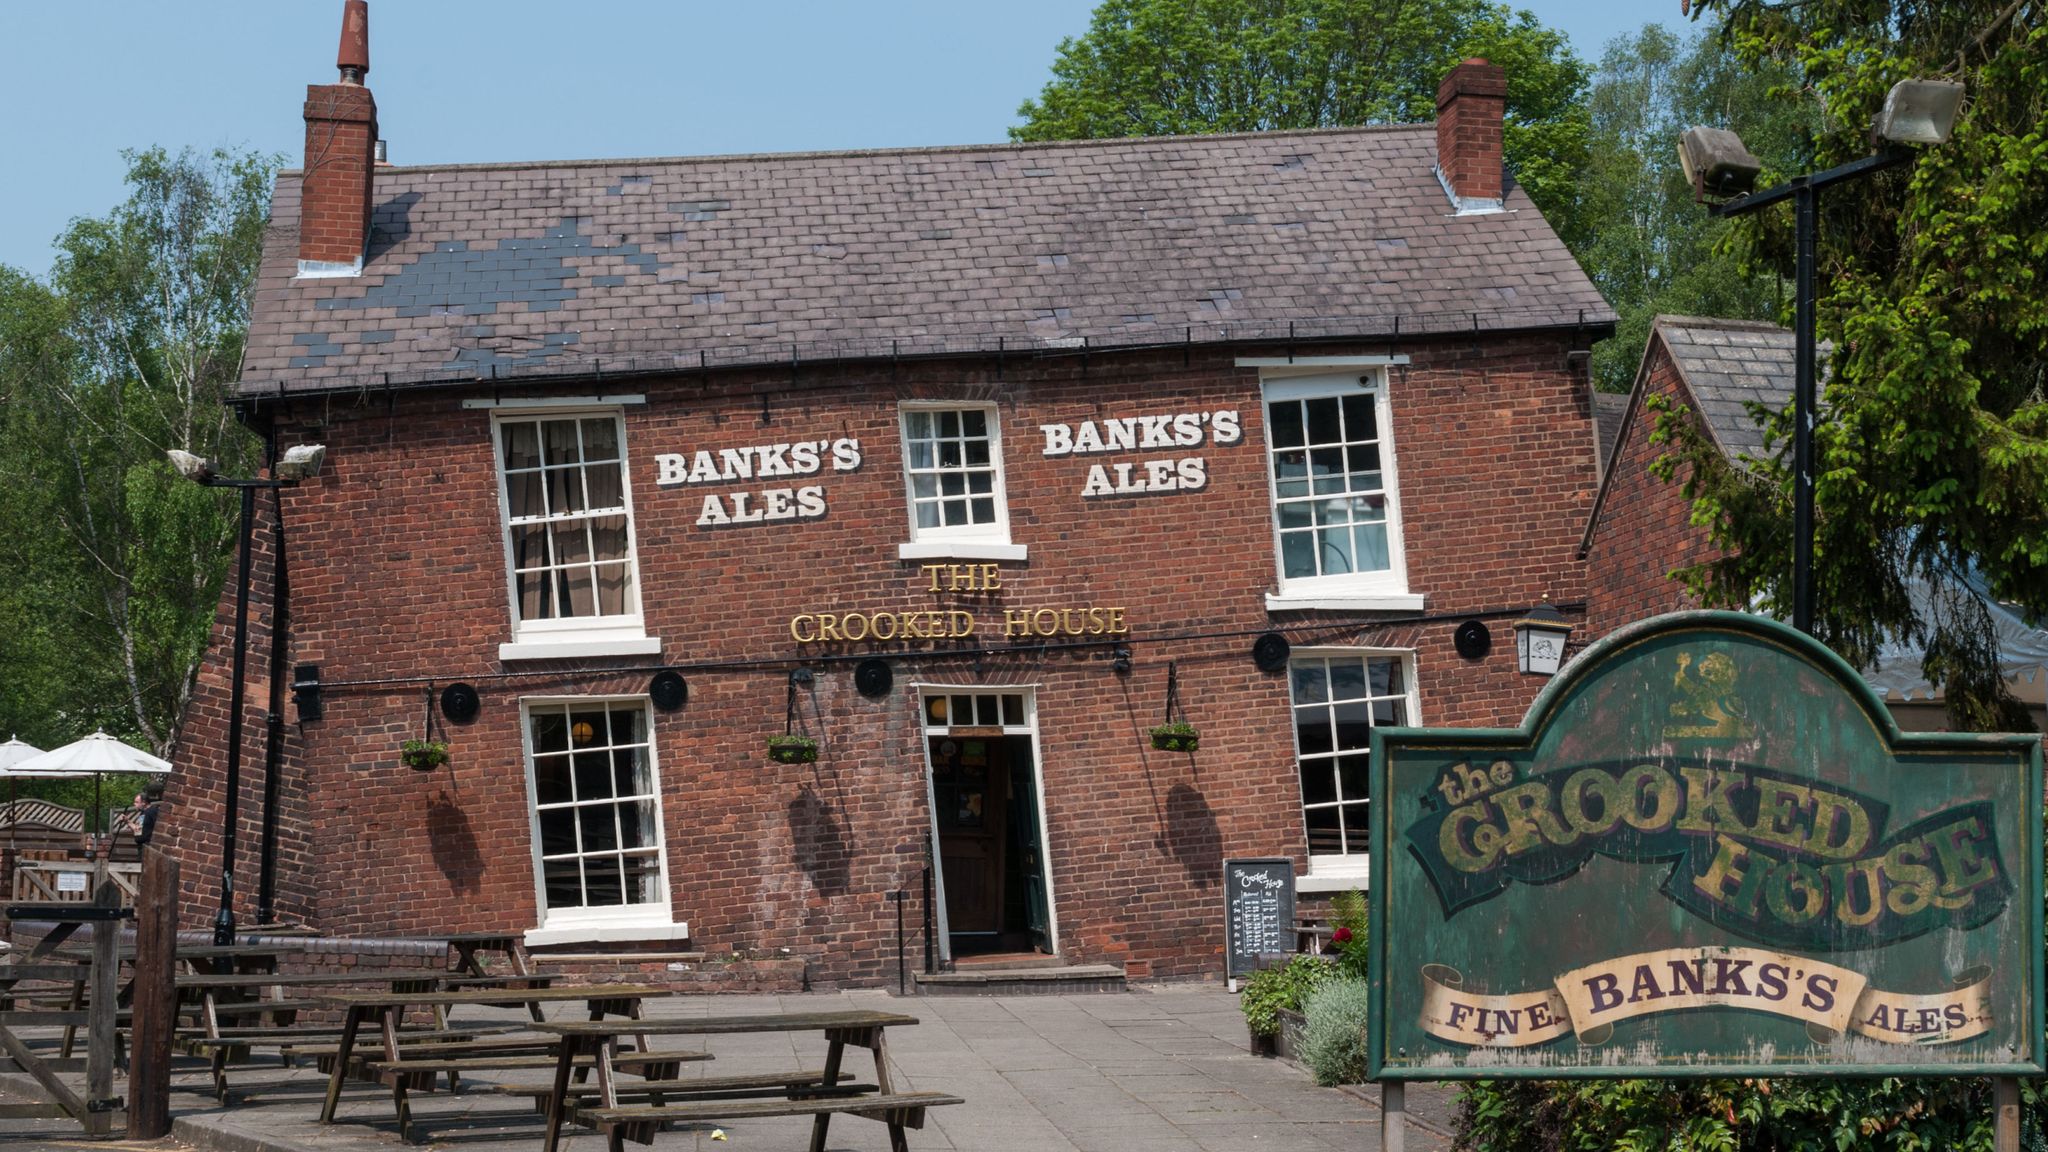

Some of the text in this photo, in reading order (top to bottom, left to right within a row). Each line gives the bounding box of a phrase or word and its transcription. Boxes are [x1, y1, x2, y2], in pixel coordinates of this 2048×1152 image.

[1041, 410, 1241, 455] BANKS'S
[655, 438, 861, 485] BANKS'S
[1082, 457, 1206, 497] ALES
[696, 485, 826, 525] ALES
[923, 563, 1001, 592] THE
[791, 606, 1128, 642] CROOKED HOUSE
[1438, 760, 1514, 806] the
[1439, 764, 1872, 873] CROOKED
[1693, 816, 1995, 926] HOUSE
[1583, 958, 1839, 1013] BANKS'S
[1446, 1000, 1967, 1034] FINE ALES
